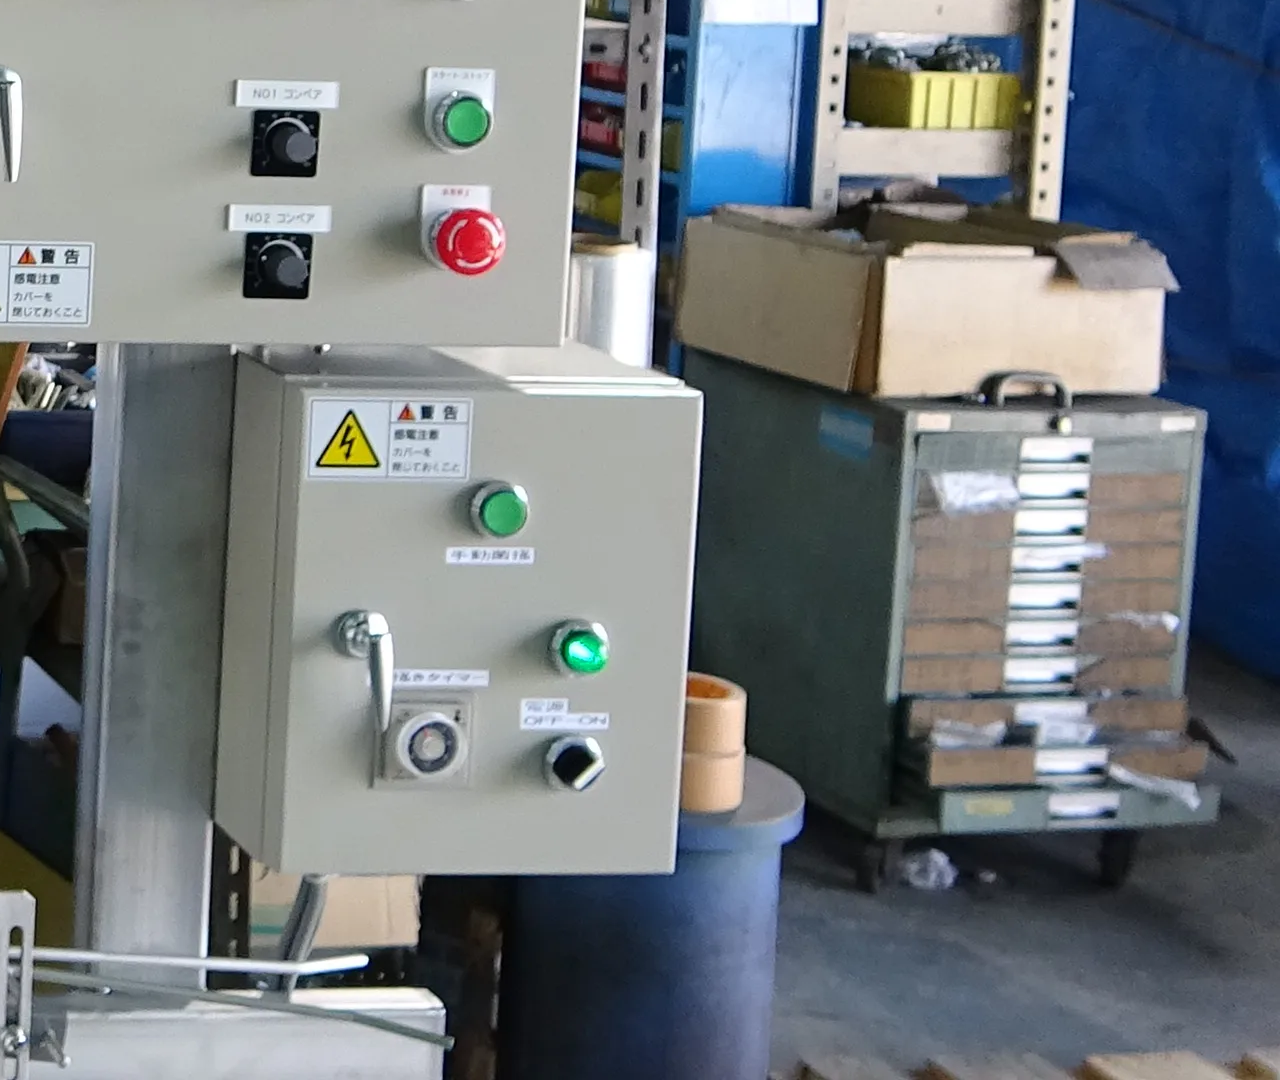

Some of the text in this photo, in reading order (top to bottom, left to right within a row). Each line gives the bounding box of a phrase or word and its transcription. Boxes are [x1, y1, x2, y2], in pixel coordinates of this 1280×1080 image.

[283, 88, 323, 100] コンベア
[276, 212, 316, 224] コンベア
[41, 248, 80, 265] 警告
[13, 273, 61, 285] 感電注意
[12, 291, 53, 302] カバーを
[11, 306, 83, 318] 閉じておくこと
[393, 429, 439, 441] 感電注意
